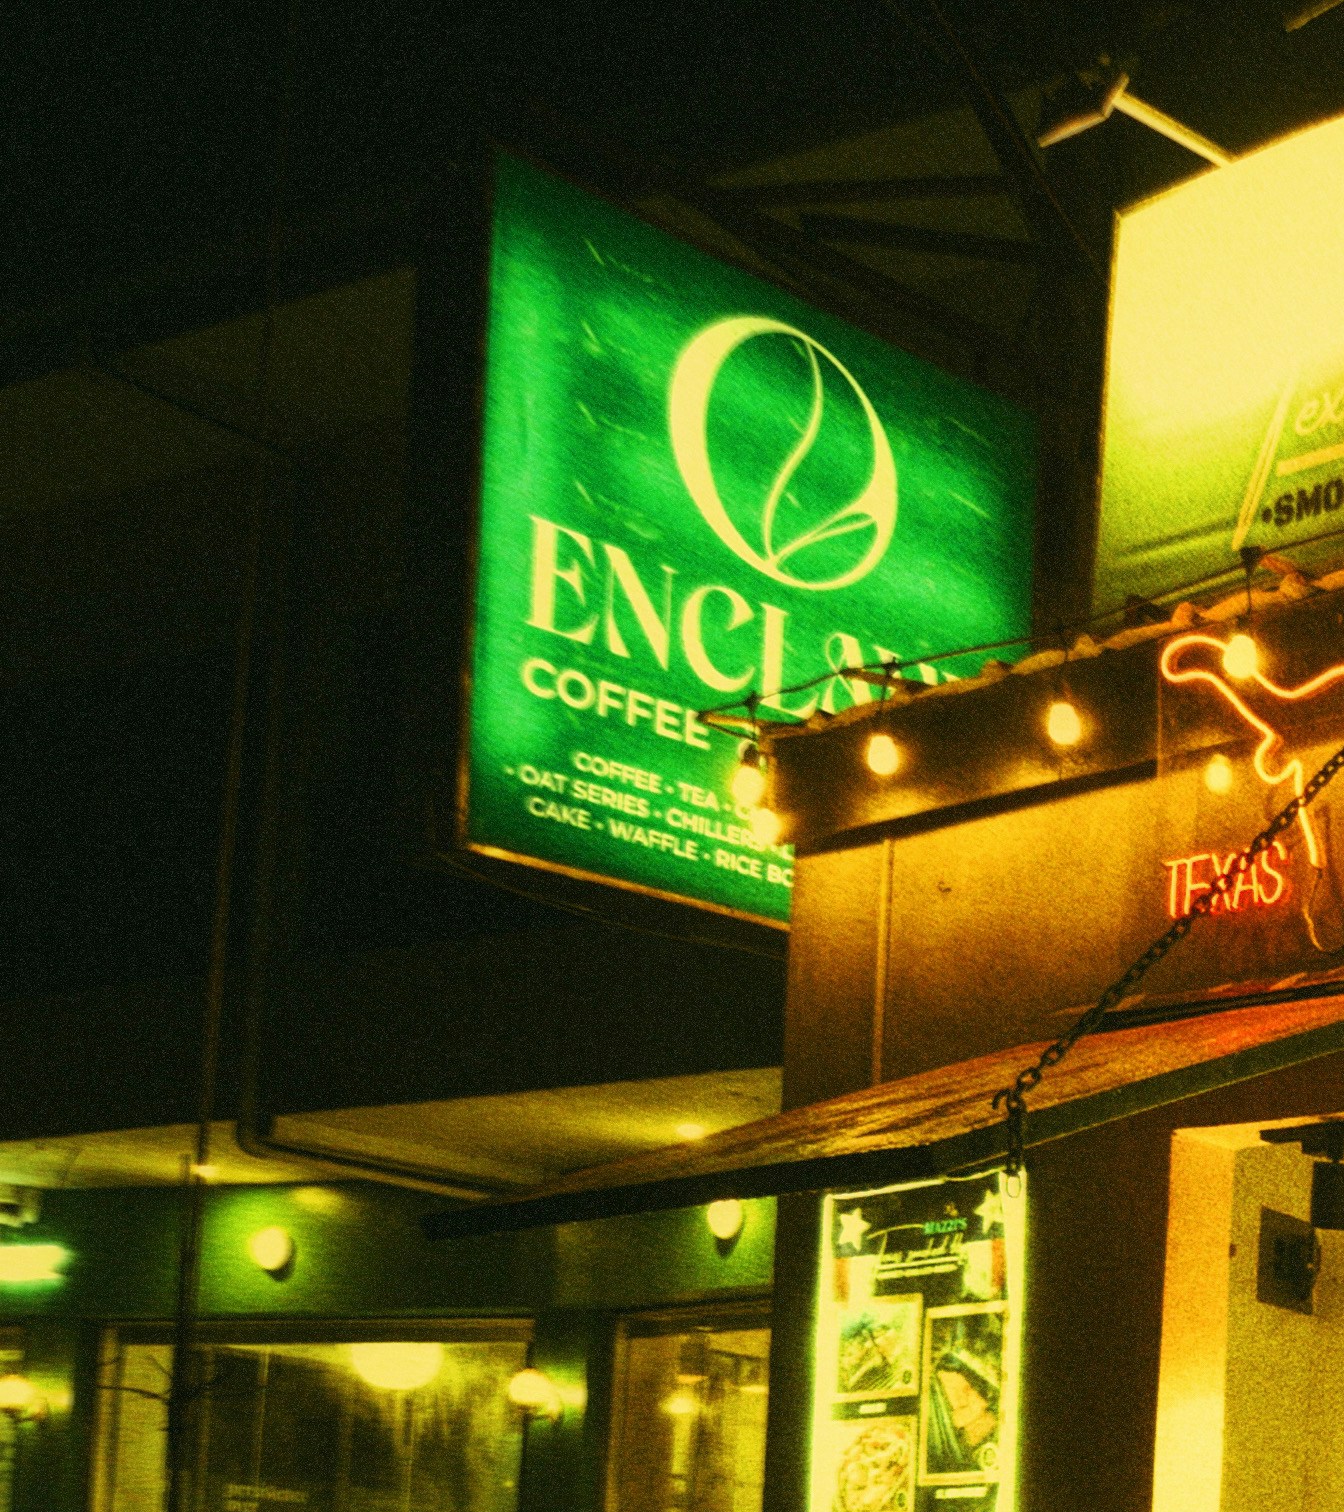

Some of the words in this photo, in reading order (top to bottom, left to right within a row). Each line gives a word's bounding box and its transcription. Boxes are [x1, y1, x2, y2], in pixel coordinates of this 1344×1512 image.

[524, 514, 960, 722] ENCLA
[519, 657, 711, 751] COFFEE
[517, 763, 568, 793] OAT
[572, 778, 651, 819] SERIES
[572, 750, 663, 795] COFFEE
[677, 780, 720, 812] TEA
[526, 795, 593, 832] CAKE
[608, 817, 699, 861] WAFFLE
[714, 848, 763, 879] RICE
[1163, 841, 1290, 918] TEXAS
